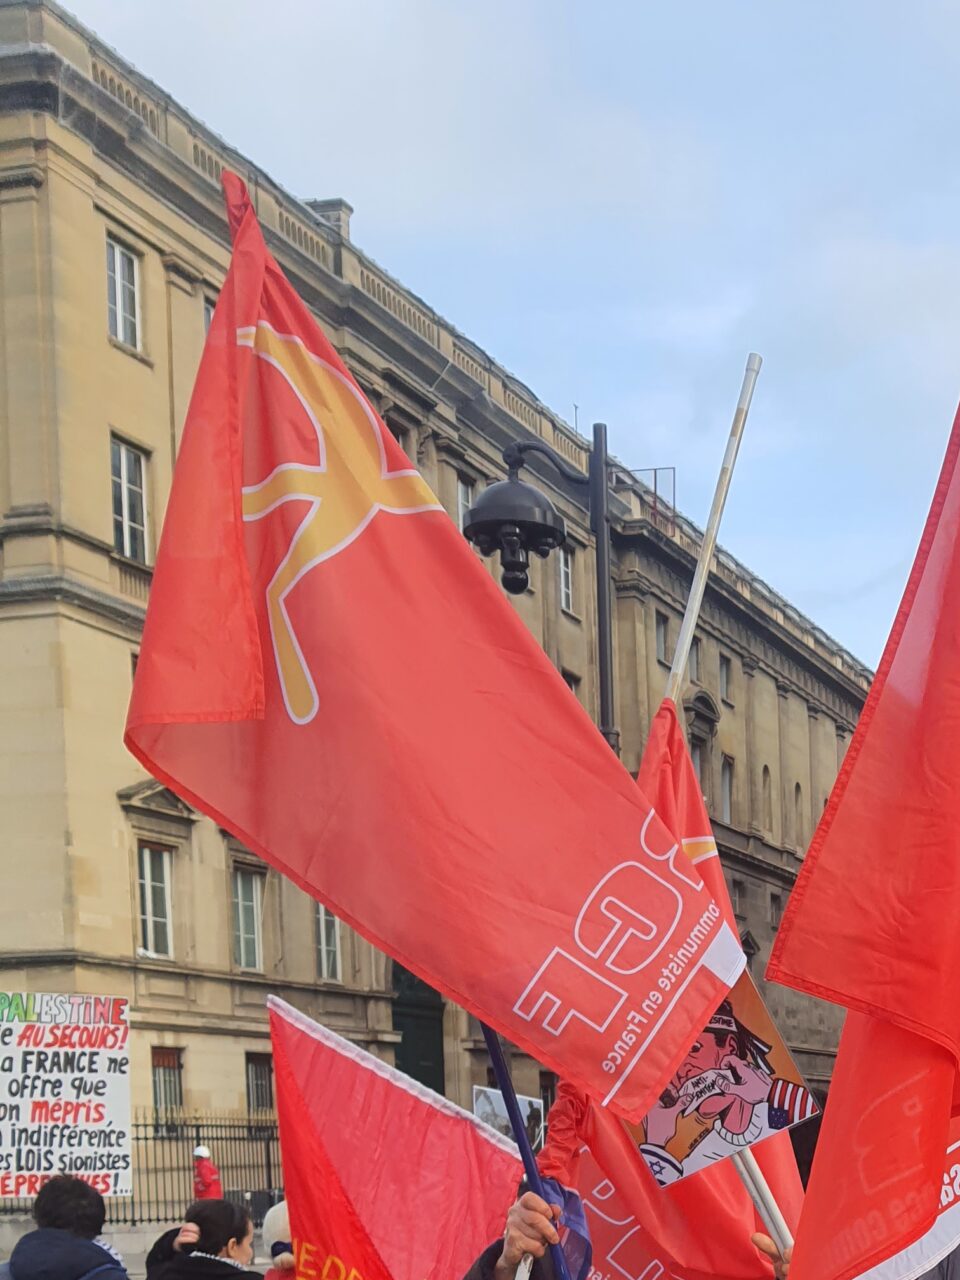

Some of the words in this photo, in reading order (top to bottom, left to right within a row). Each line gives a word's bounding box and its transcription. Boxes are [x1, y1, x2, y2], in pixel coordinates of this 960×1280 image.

[16, 1023, 45, 1047] AU
[21, 1051, 99, 1074] FRANCE
[107, 1056, 129, 1074] ne
[8, 1074, 62, 1098] offre
[70, 1076, 107, 1099] que
[10, 1122, 126, 1147] indifférence
[58, 1151, 130, 1171] sionistes
